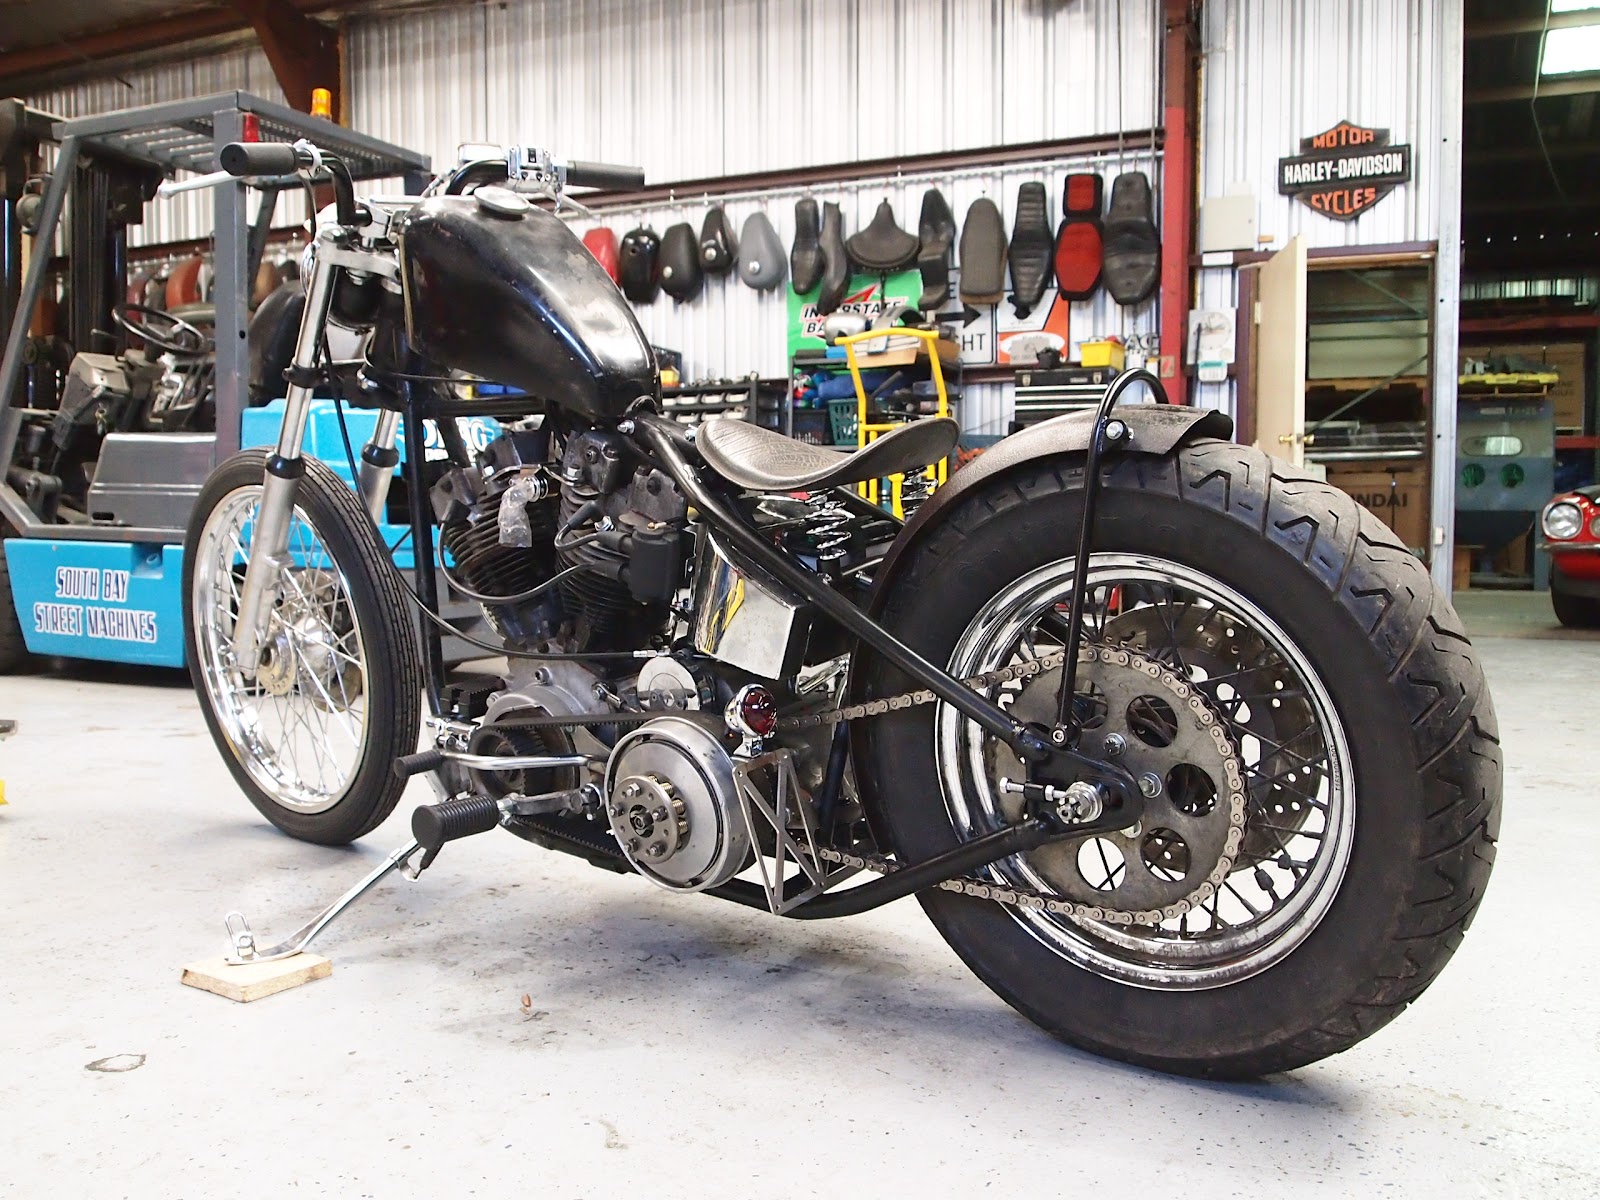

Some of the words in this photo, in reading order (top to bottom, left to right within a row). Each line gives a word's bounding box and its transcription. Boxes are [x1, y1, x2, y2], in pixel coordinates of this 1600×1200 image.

[1313, 124, 1374, 148] MOTOR
[1284, 153, 1402, 184] HARLEY-DAVIDSON
[1311, 187, 1376, 215] CYCLES
[56, 567, 99, 599] SOUTH
[103, 569, 129, 601] BAY
[34, 603, 82, 635] STREET
[87, 607, 157, 643] MACHINES
